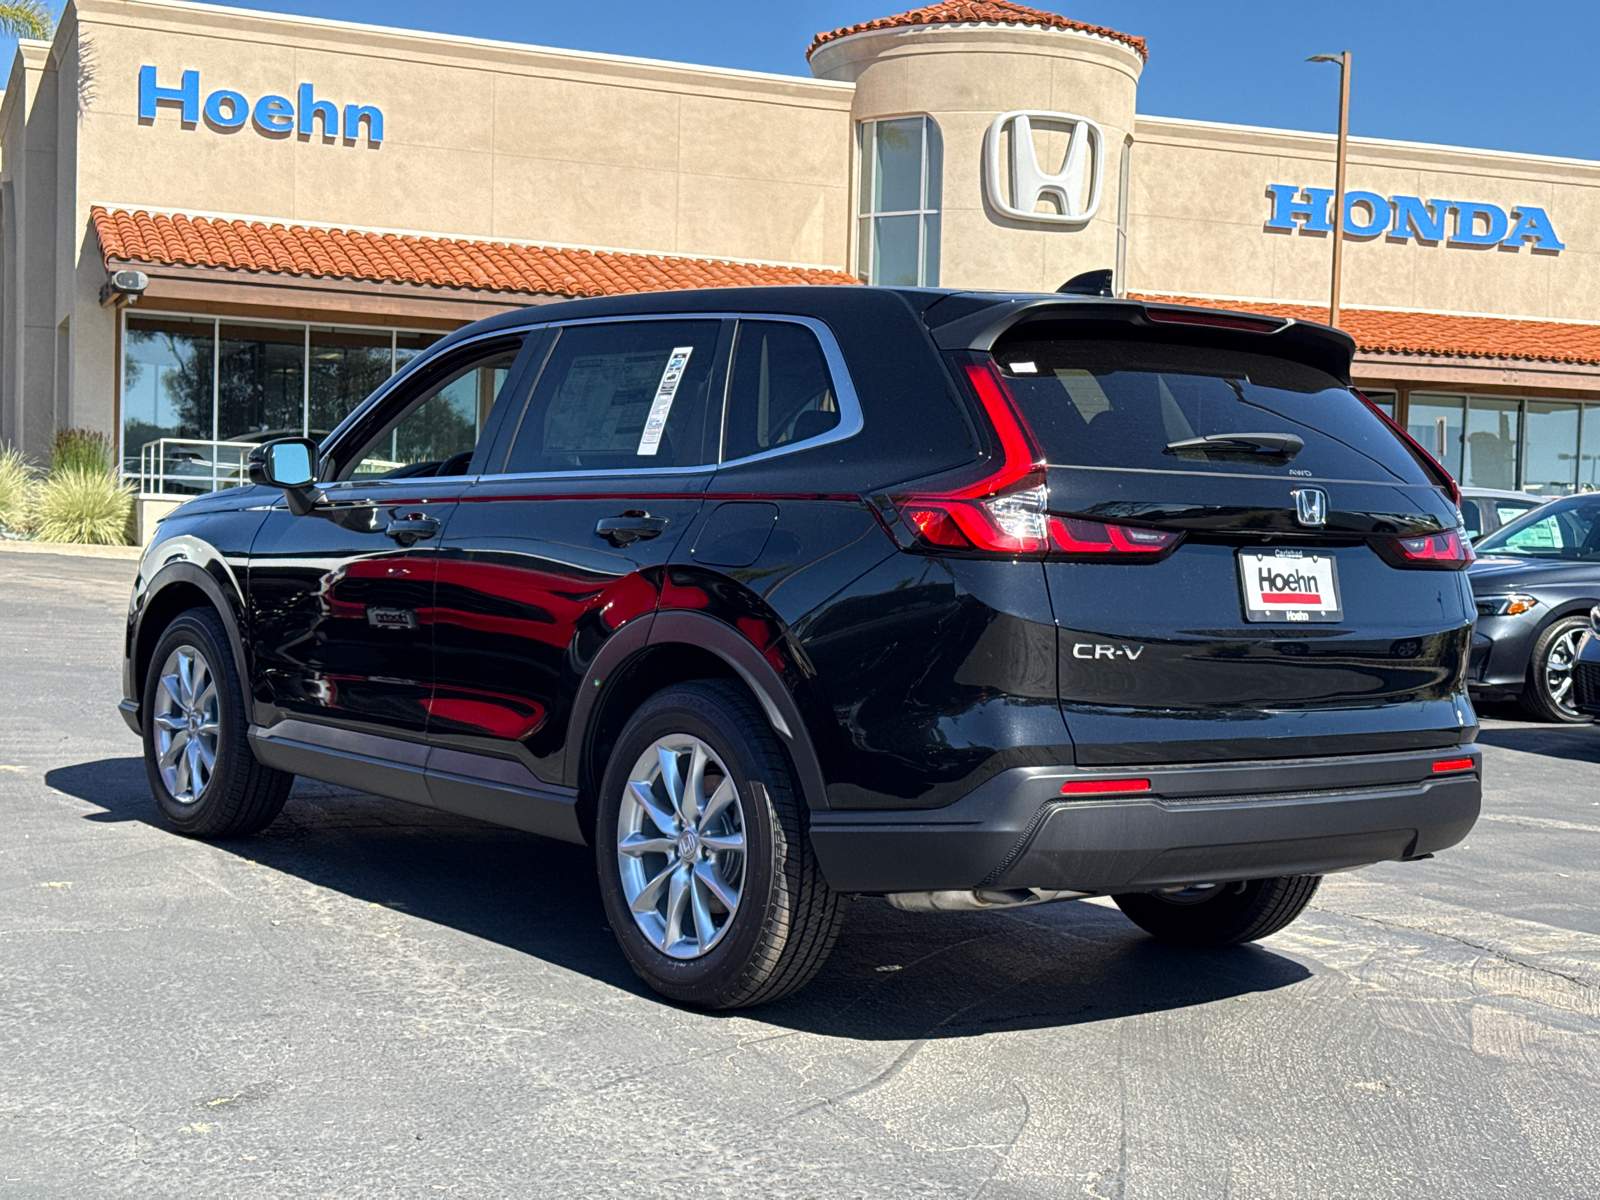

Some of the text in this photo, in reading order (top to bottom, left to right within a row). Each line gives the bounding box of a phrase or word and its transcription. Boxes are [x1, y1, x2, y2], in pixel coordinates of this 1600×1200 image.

[138, 65, 384, 142] Hoehn
[1265, 184, 1566, 251] HONDA
[1289, 469, 1312, 477] AWD
[1258, 567, 1320, 593] Hoehn
[1286, 610, 1309, 621] Hoehn
[1072, 643, 1145, 661] CR-V
